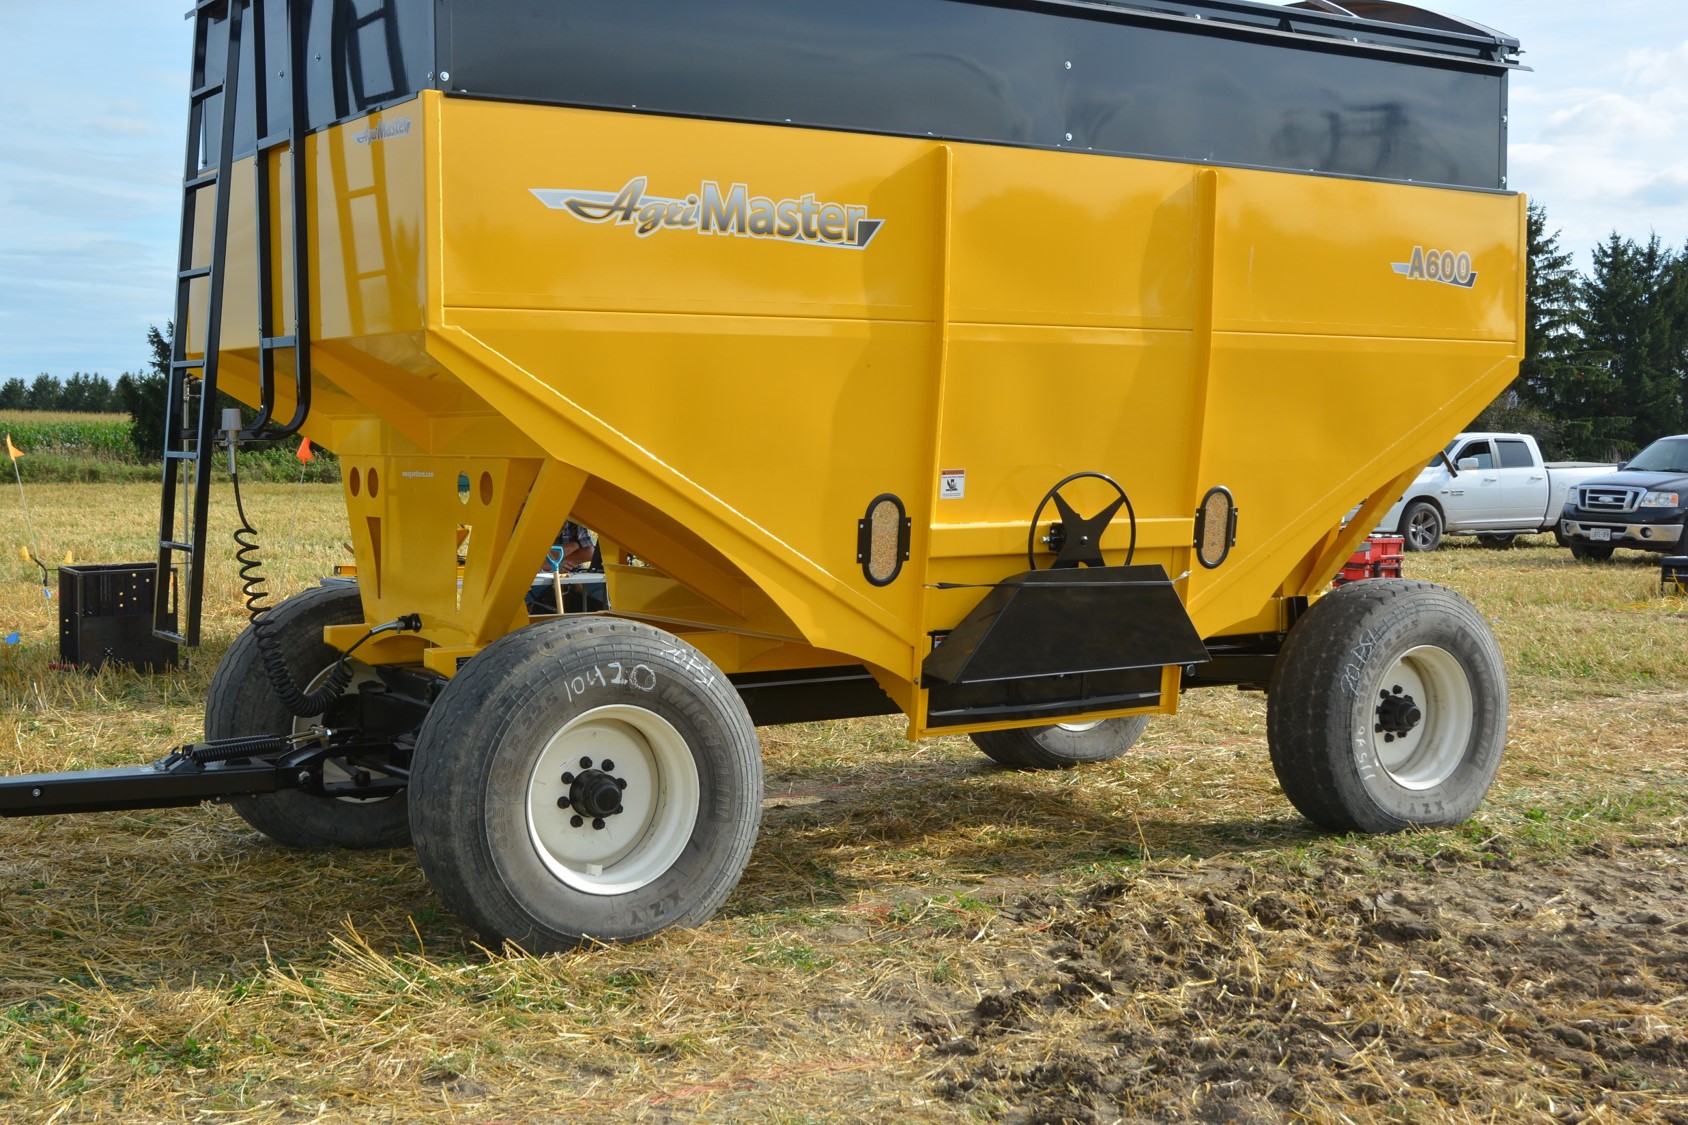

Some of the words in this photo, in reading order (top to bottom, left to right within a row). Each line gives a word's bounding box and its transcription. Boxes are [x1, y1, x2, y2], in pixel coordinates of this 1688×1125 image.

[1407, 246, 1471, 283] A600
[563, 661, 657, 702] 10420
[662, 685, 732, 819] MICHELIN
